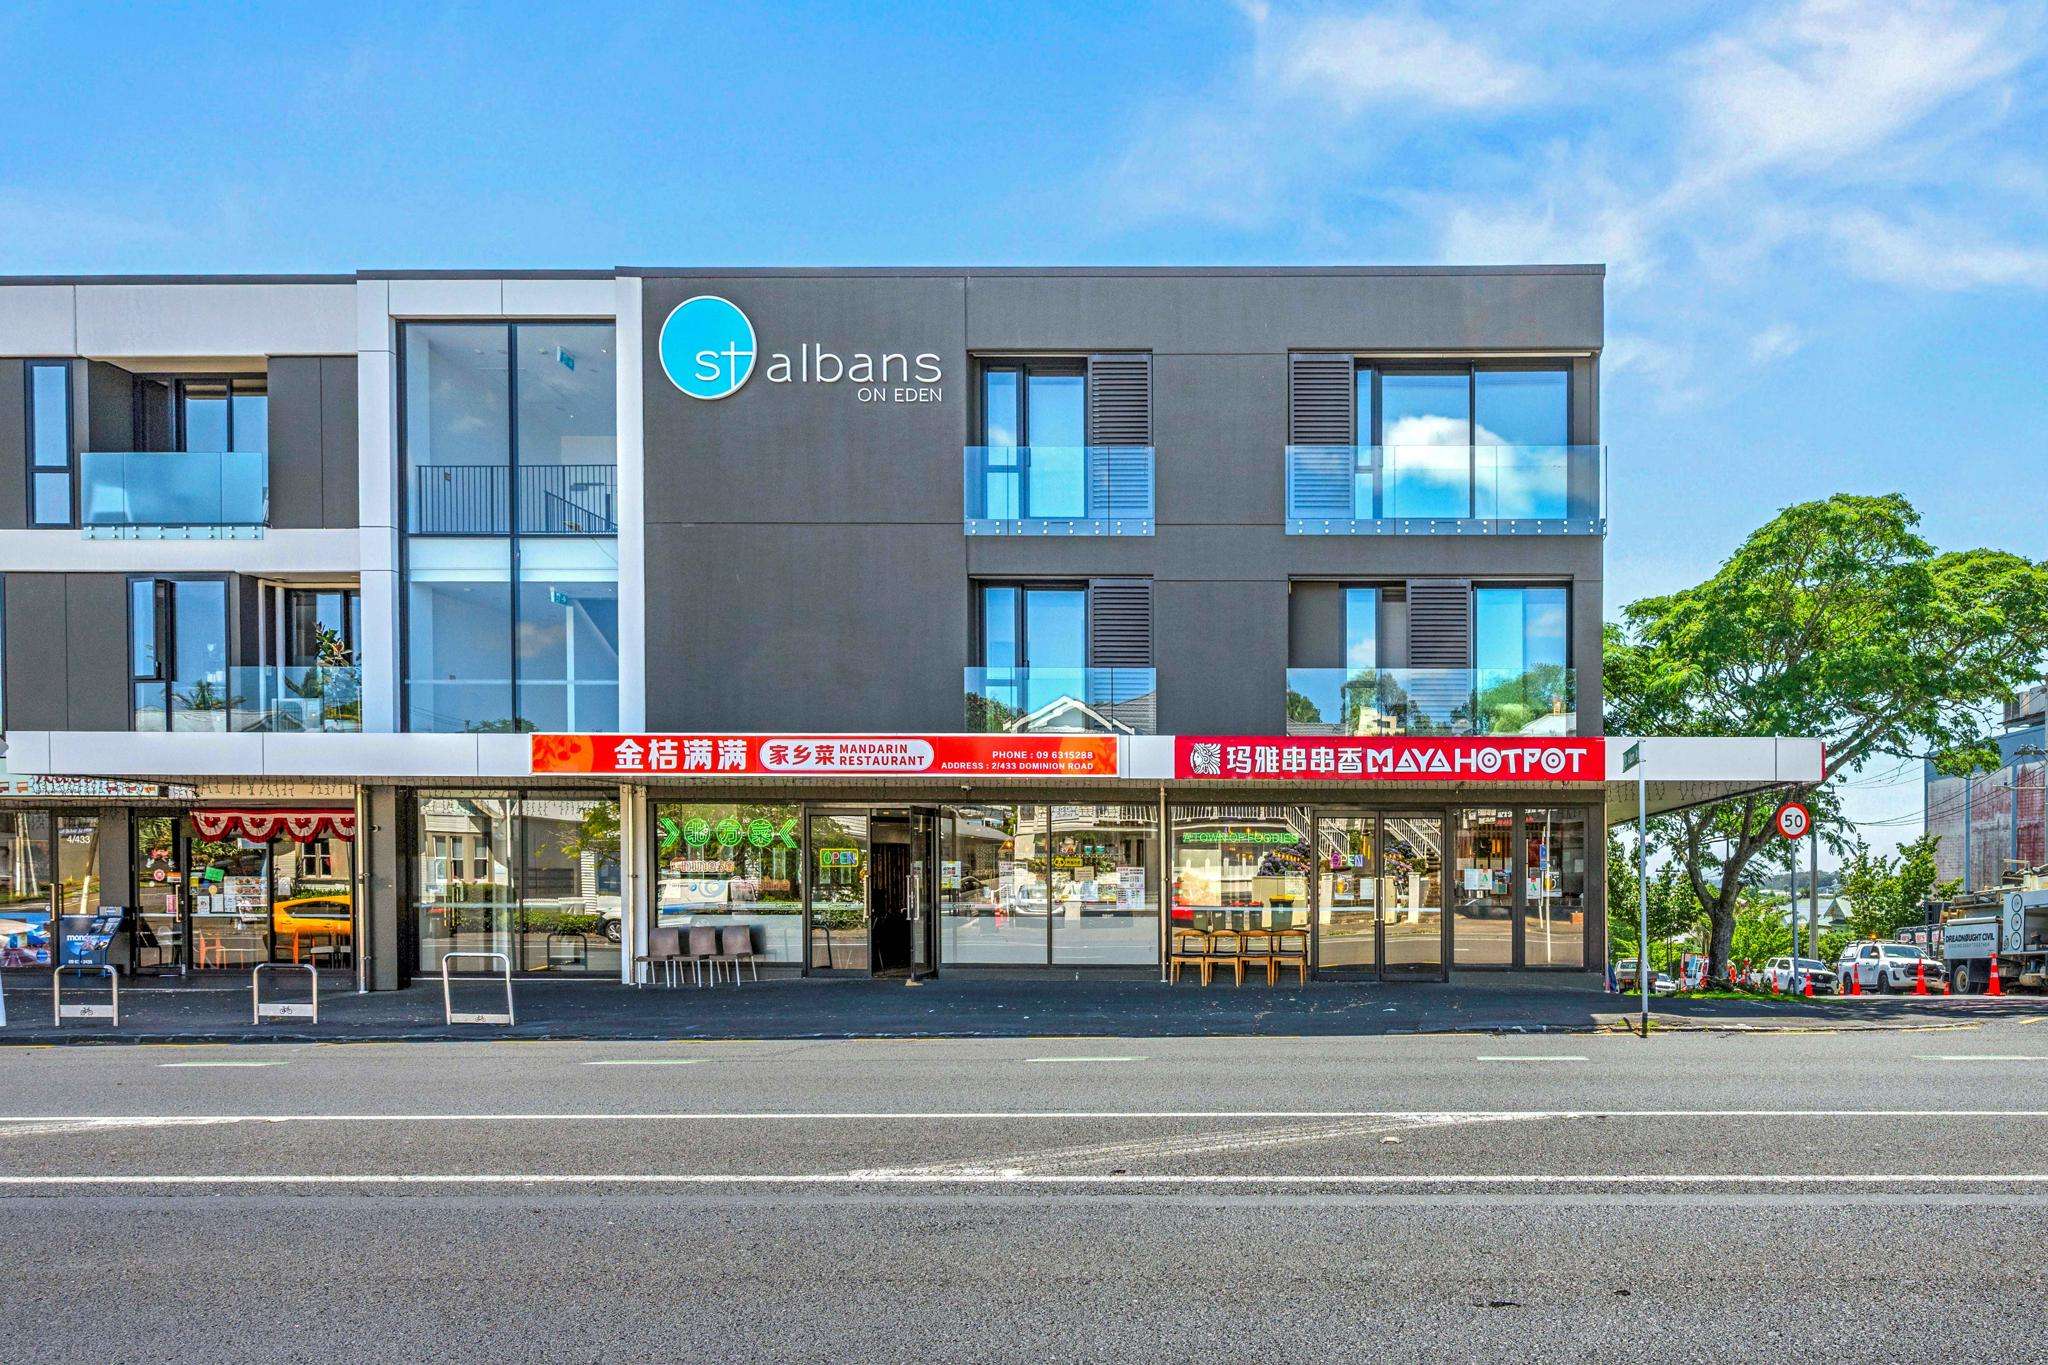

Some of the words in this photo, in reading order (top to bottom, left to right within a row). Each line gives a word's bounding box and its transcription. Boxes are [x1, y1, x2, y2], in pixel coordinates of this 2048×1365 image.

[694, 340, 753, 390] st
[766, 343, 943, 383] albans
[857, 387, 886, 402] ON
[894, 387, 942, 402] EDEN
[614, 738, 748, 770] 金桔满满
[769, 744, 835, 766] 家乡菜
[839, 744, 908, 754] MANDARIN
[992, 751, 1027, 759] PHONE
[1036, 751, 1049, 759] 09
[1051, 751, 1094, 759] 6315288
[839, 755, 925, 766] RESTAURANT
[941, 762, 984, 770] ADDRESS
[991, 762, 1017, 770] 2/433
[1019, 762, 1065, 770] DOMINION
[1067, 762, 1094, 770] ROAD
[1226, 745, 1363, 774] 玛雅串串香
[1784, 814, 1803, 828] 50
[66, 834, 91, 844] 4/433
[823, 851, 857, 865] OPEN
[1330, 851, 1364, 868] OPEN
[1982, 932, 1995, 941] CIVIL
